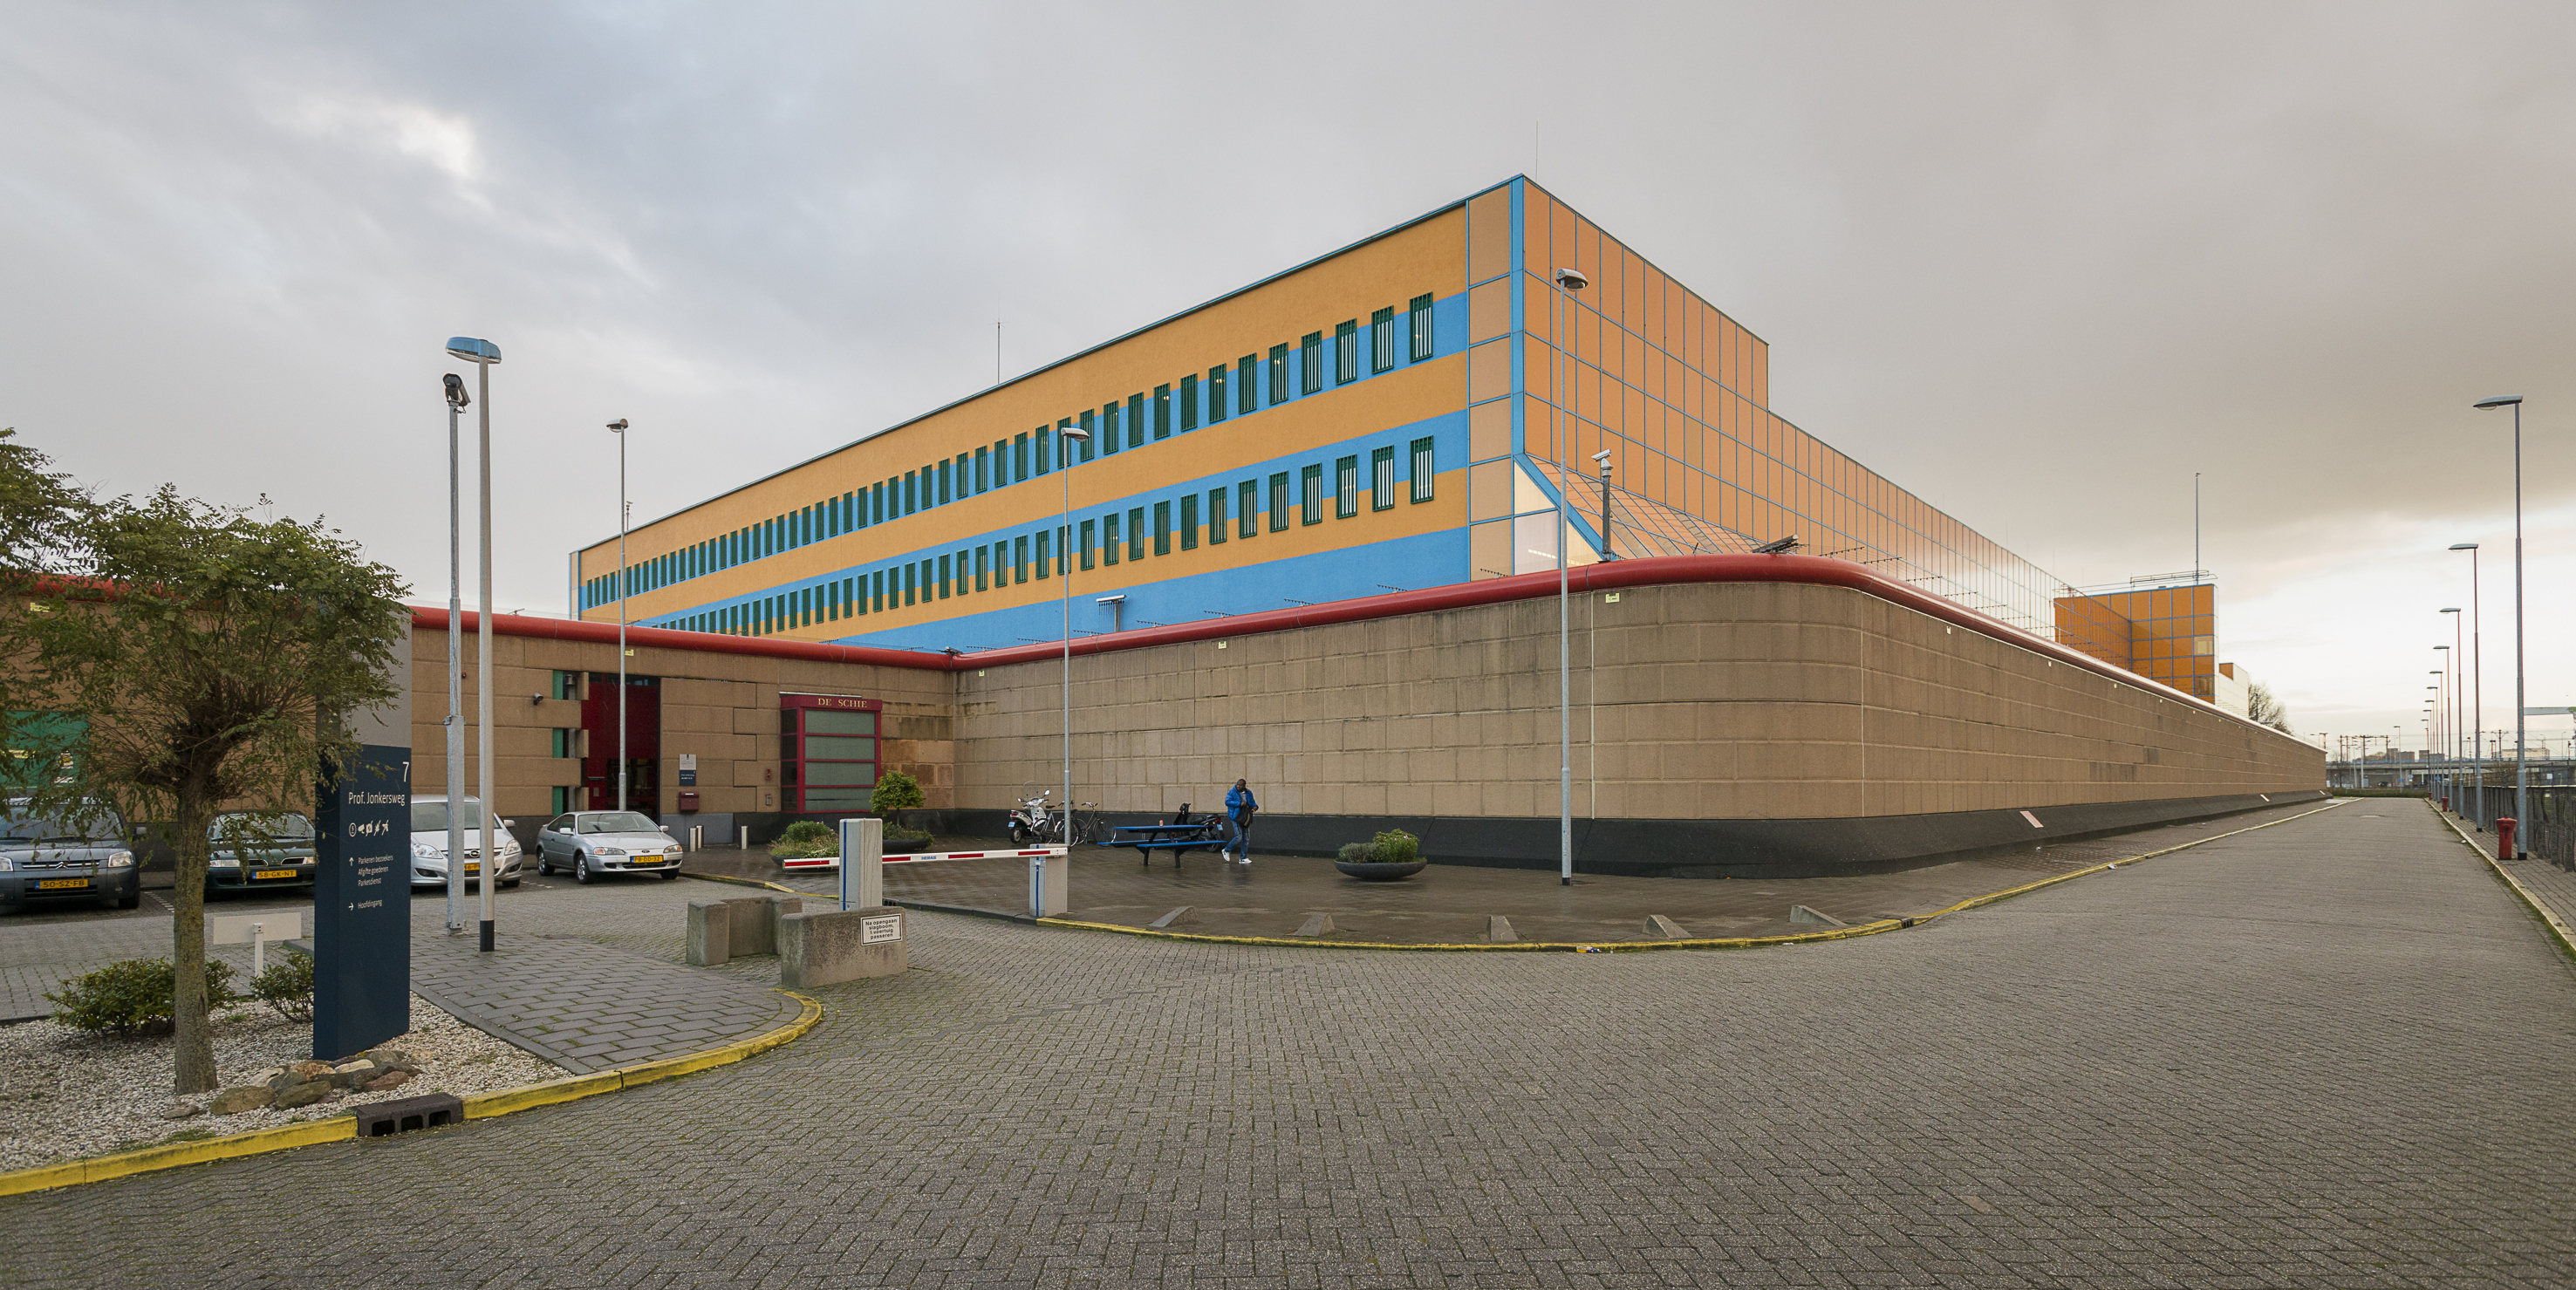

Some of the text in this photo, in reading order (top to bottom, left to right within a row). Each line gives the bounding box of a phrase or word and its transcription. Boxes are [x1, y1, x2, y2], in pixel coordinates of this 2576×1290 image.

[817, 698, 868, 708] DE SCHIE
[402, 761, 410, 782] 7
[349, 791, 406, 806] Prof. Jonkersweg
[375, 854, 393, 863] bezoekers
